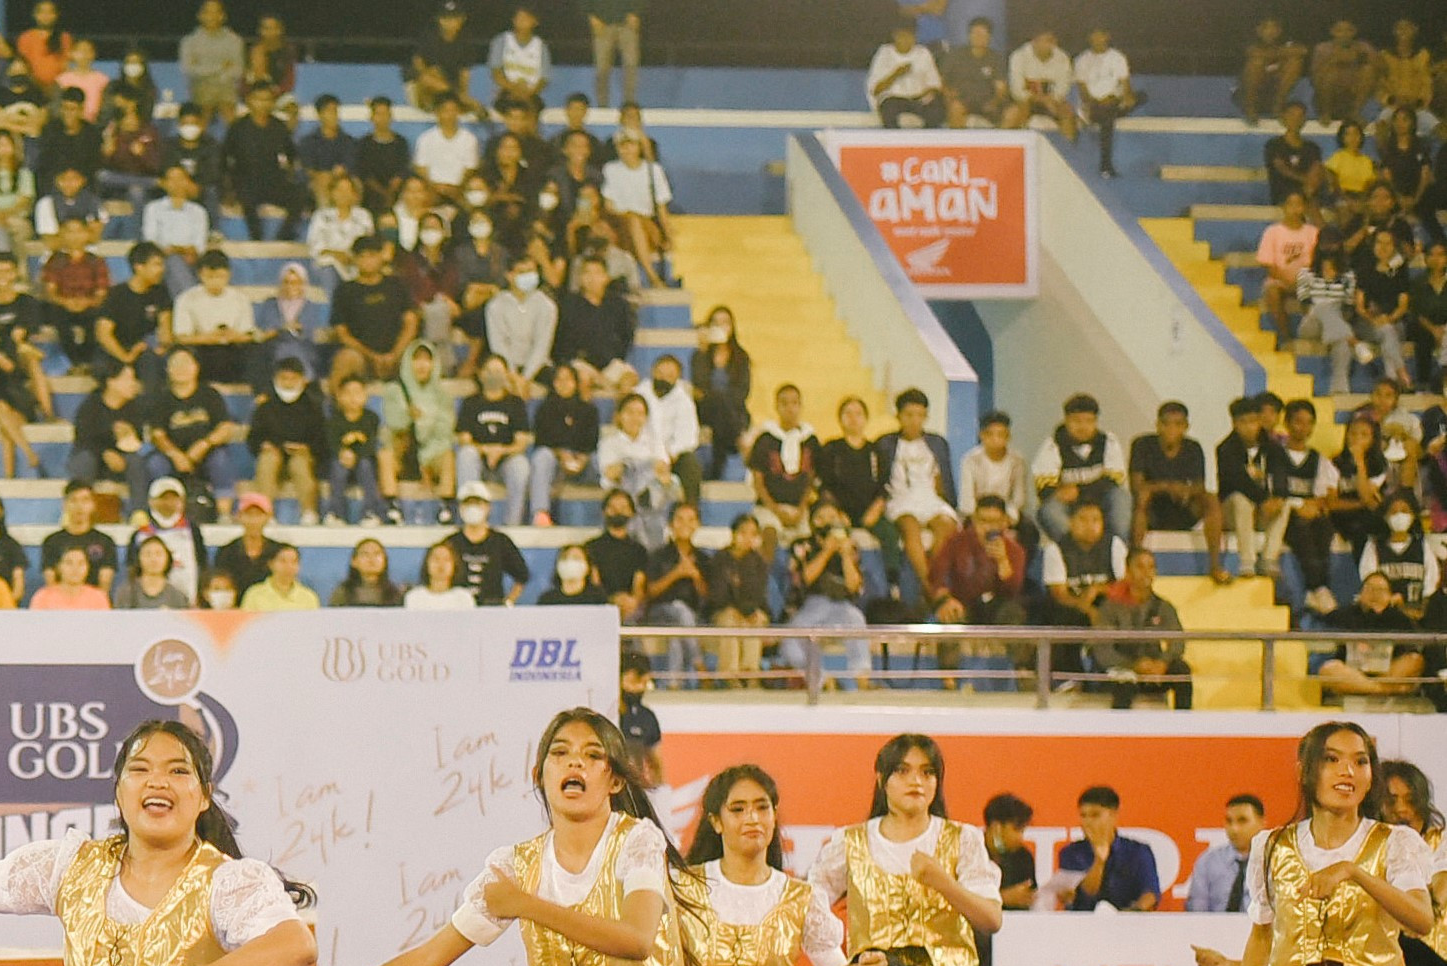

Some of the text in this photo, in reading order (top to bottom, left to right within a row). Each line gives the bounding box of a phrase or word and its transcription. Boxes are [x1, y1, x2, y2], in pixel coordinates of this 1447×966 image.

[377, 642, 428, 661] UBS
[511, 639, 581, 667] DBL
[376, 663, 451, 682] GOLD
[10, 702, 109, 740] UBS
[7, 740, 125, 779] GOL
